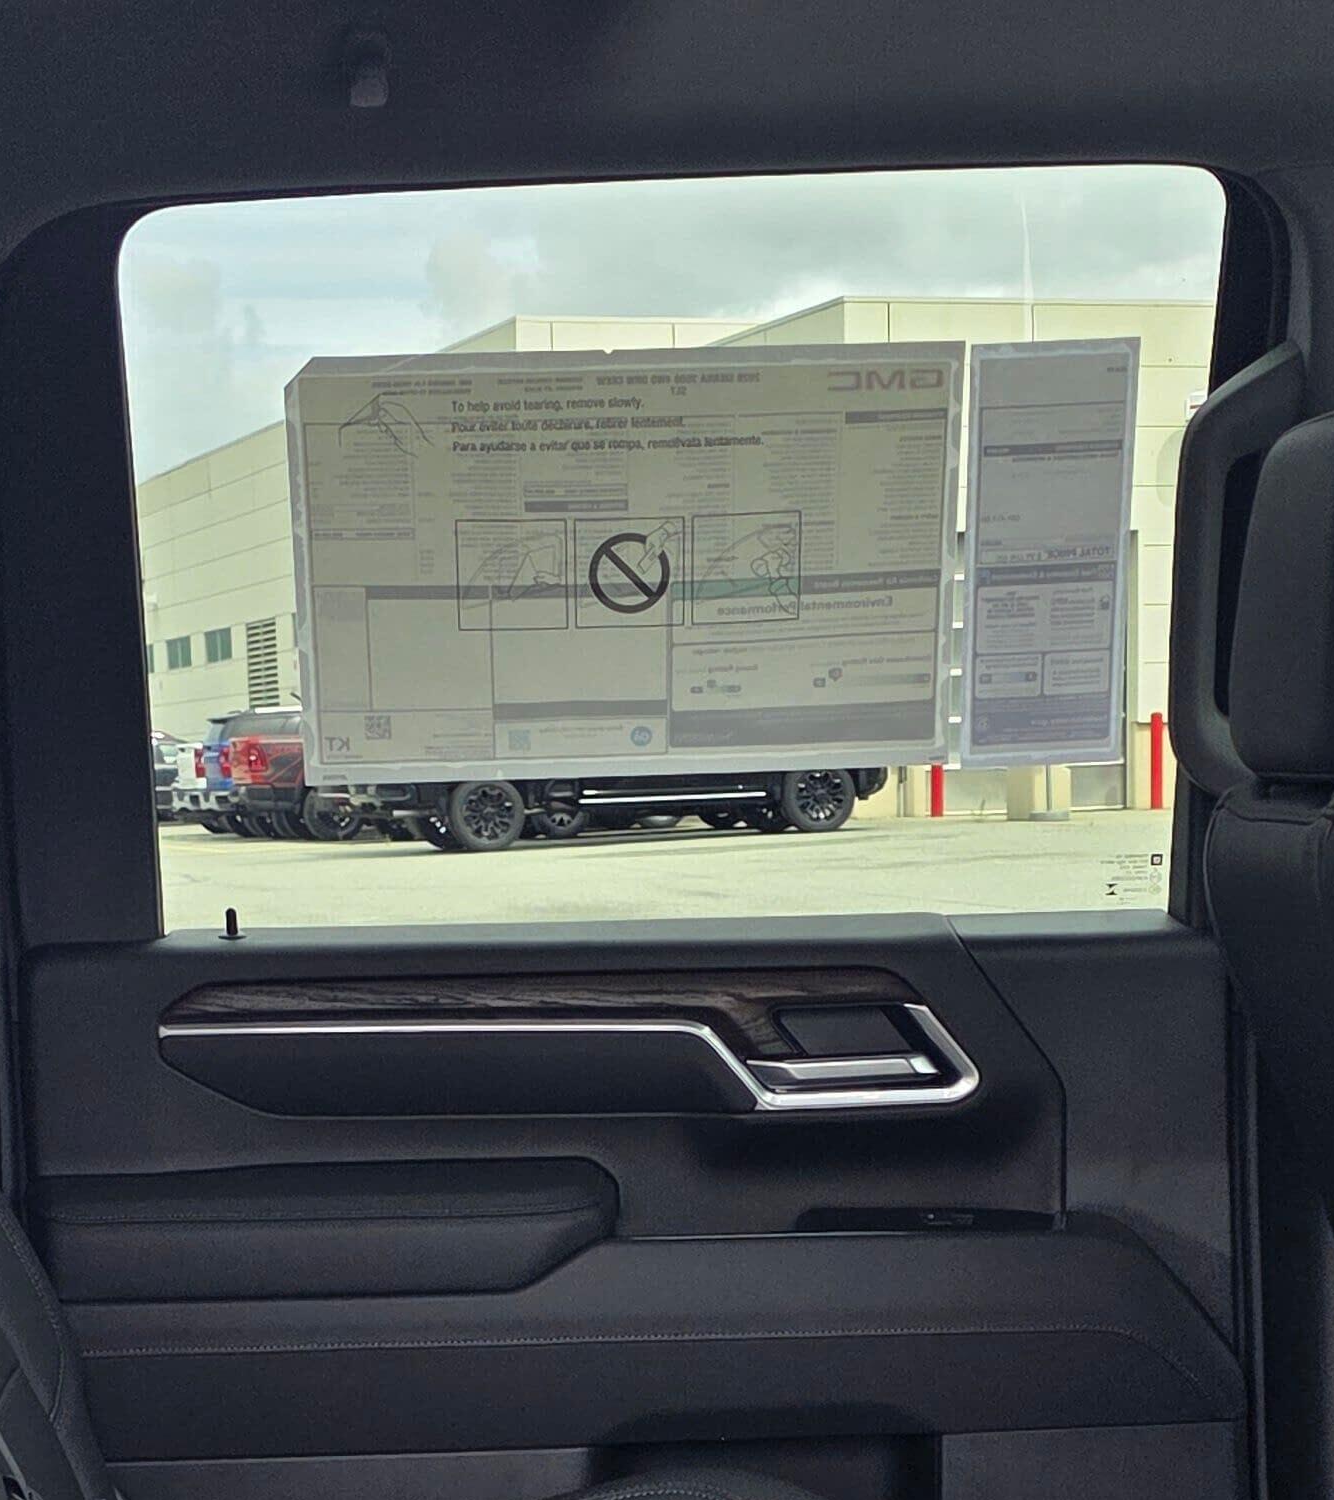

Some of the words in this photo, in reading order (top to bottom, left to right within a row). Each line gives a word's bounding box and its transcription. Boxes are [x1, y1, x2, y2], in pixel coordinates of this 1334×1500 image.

[451, 401, 465, 413] To
[467, 400, 490, 414] help
[493, 399, 521, 412] avoid
[523, 399, 563, 413] tearing,
[566, 398, 606, 409] remove
[608, 396, 644, 410] slowly.
[451, 421, 476, 433] Pour
[511, 419, 539, 431] toute
[452, 441, 477, 452] Para
[479, 440, 527, 454] ayudarse
[529, 442, 537, 451] a
[539, 439, 568, 451] evitar
[571, 440, 591, 452] que
[593, 439, 606, 450] se
[608, 438, 644, 451] rompa,
